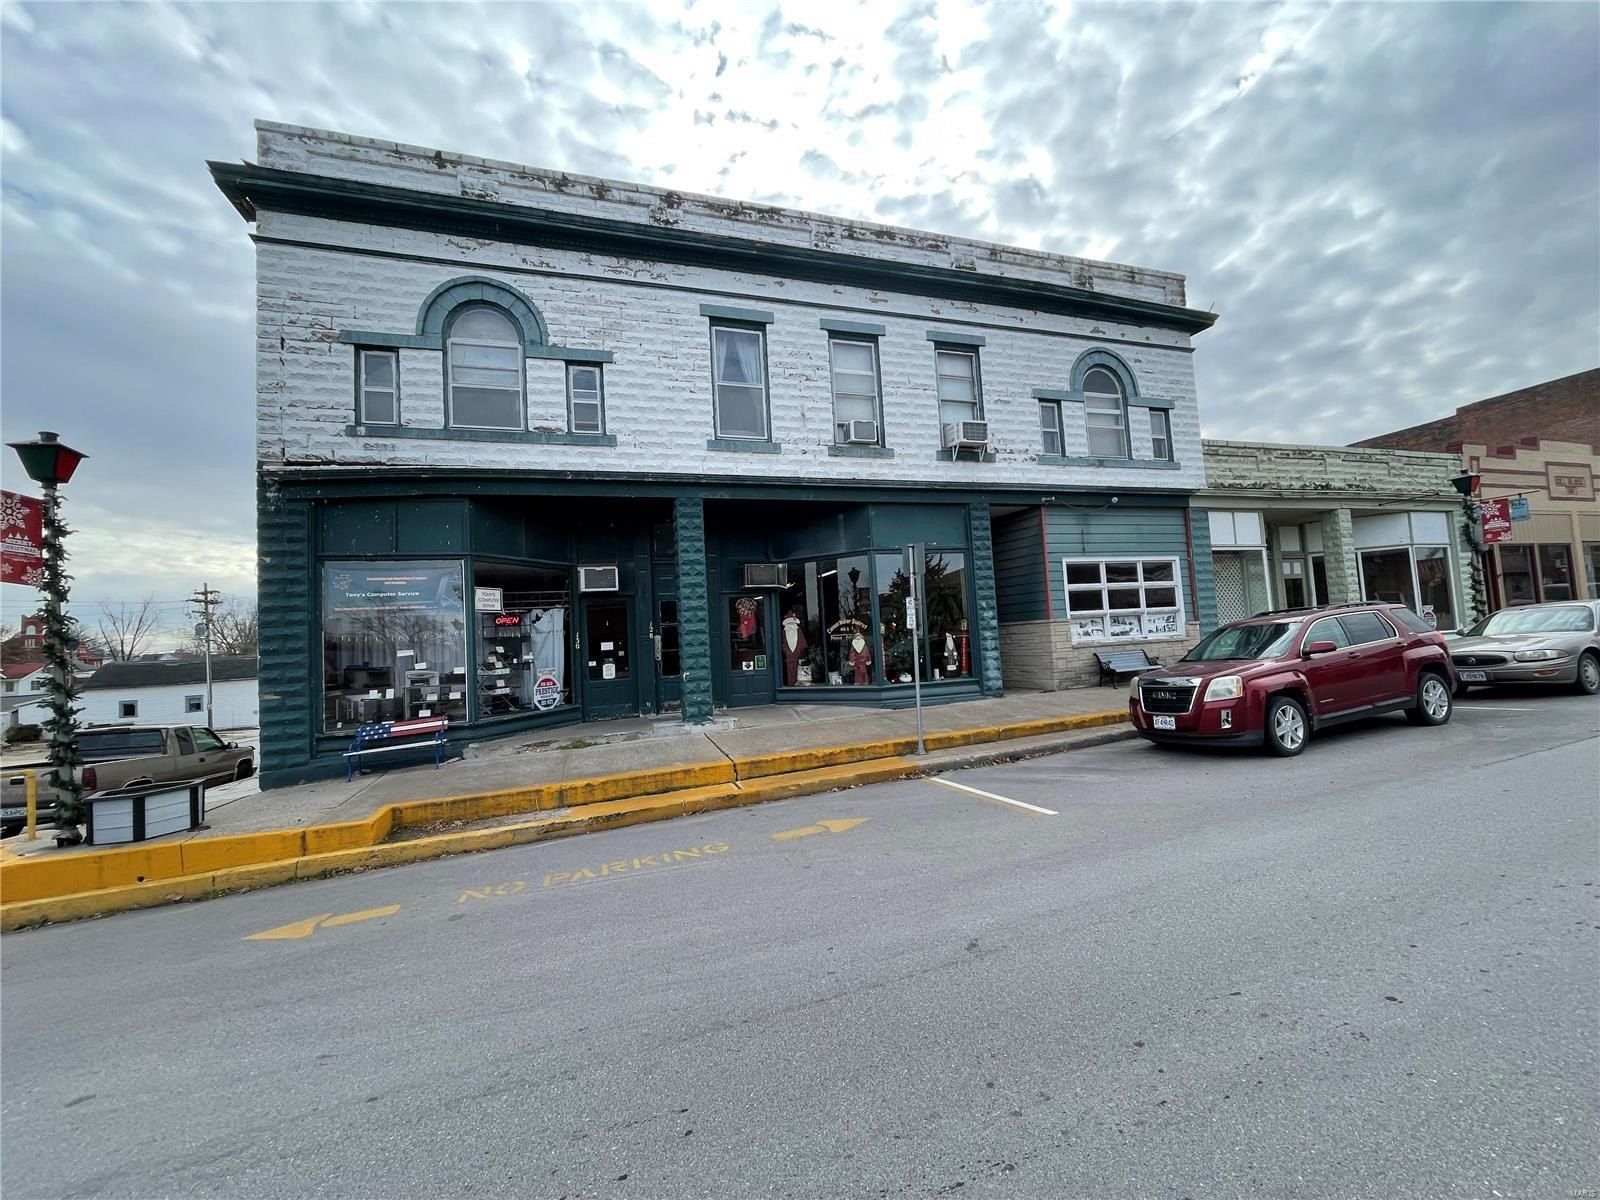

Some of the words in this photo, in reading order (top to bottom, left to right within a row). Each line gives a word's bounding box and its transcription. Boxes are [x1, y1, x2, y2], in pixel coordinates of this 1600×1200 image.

[495, 616, 519, 625] OPEN
[1152, 691, 1177, 700] GMC
[459, 881, 525, 903] NO
[543, 842, 729, 887] PARKING
